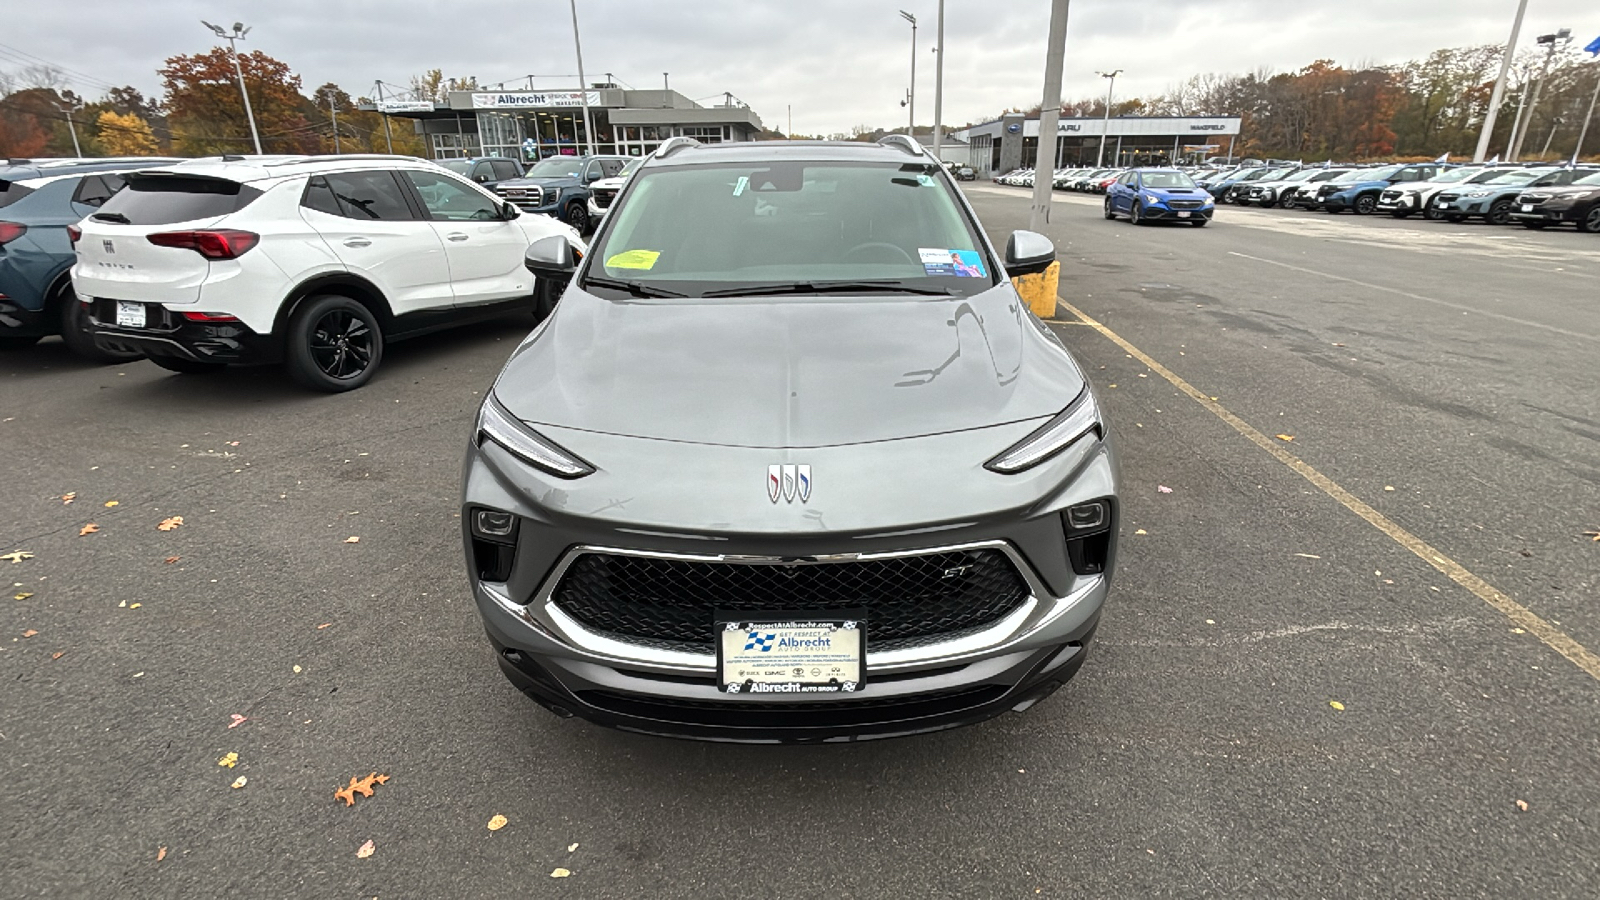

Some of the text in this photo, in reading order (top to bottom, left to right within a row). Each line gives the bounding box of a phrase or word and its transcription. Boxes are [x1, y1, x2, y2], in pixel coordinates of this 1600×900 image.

[498, 94, 546, 104] Albrecht
[748, 621, 834, 630] RespectAtAlbrecht.com
[778, 637, 831, 647] Albrecht
[750, 683, 801, 693] Albrecht
